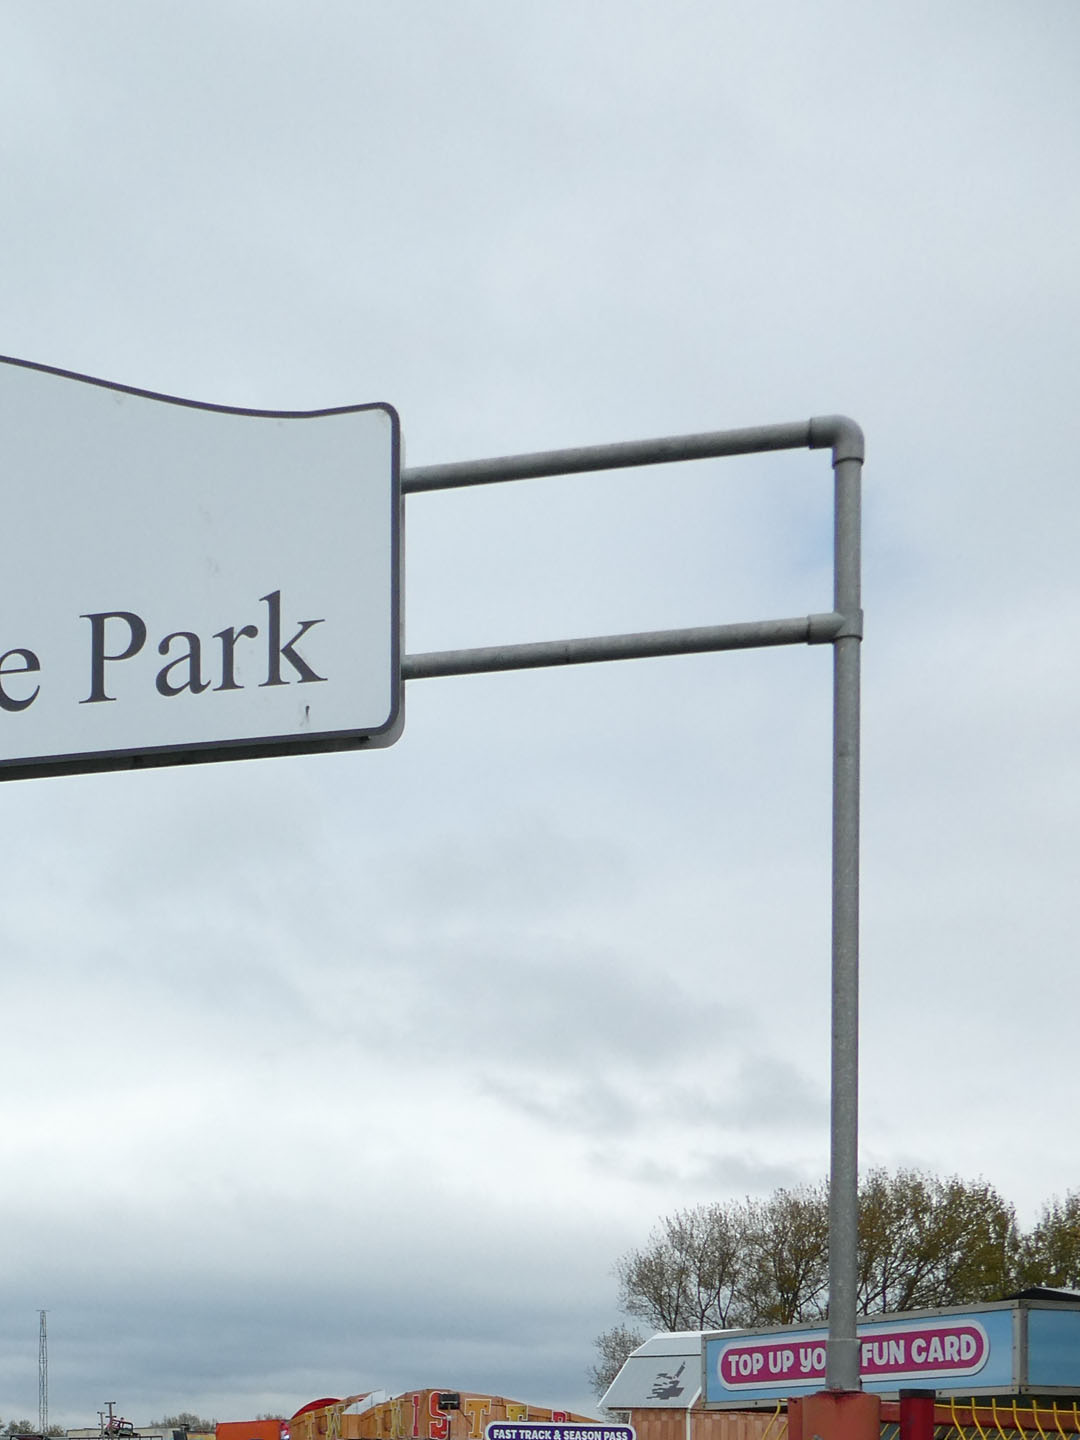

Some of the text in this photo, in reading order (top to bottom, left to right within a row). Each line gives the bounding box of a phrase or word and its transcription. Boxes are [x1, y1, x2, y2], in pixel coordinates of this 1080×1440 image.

[78, 590, 328, 704] Park
[728, 1334, 977, 1377] TOP UP YO FUN CARD
[493, 1429, 517, 1440] FAST
[519, 1429, 552, 1440] TRACK
[553, 1430, 561, 1440] &
[563, 1430, 601, 1440] SEASON
